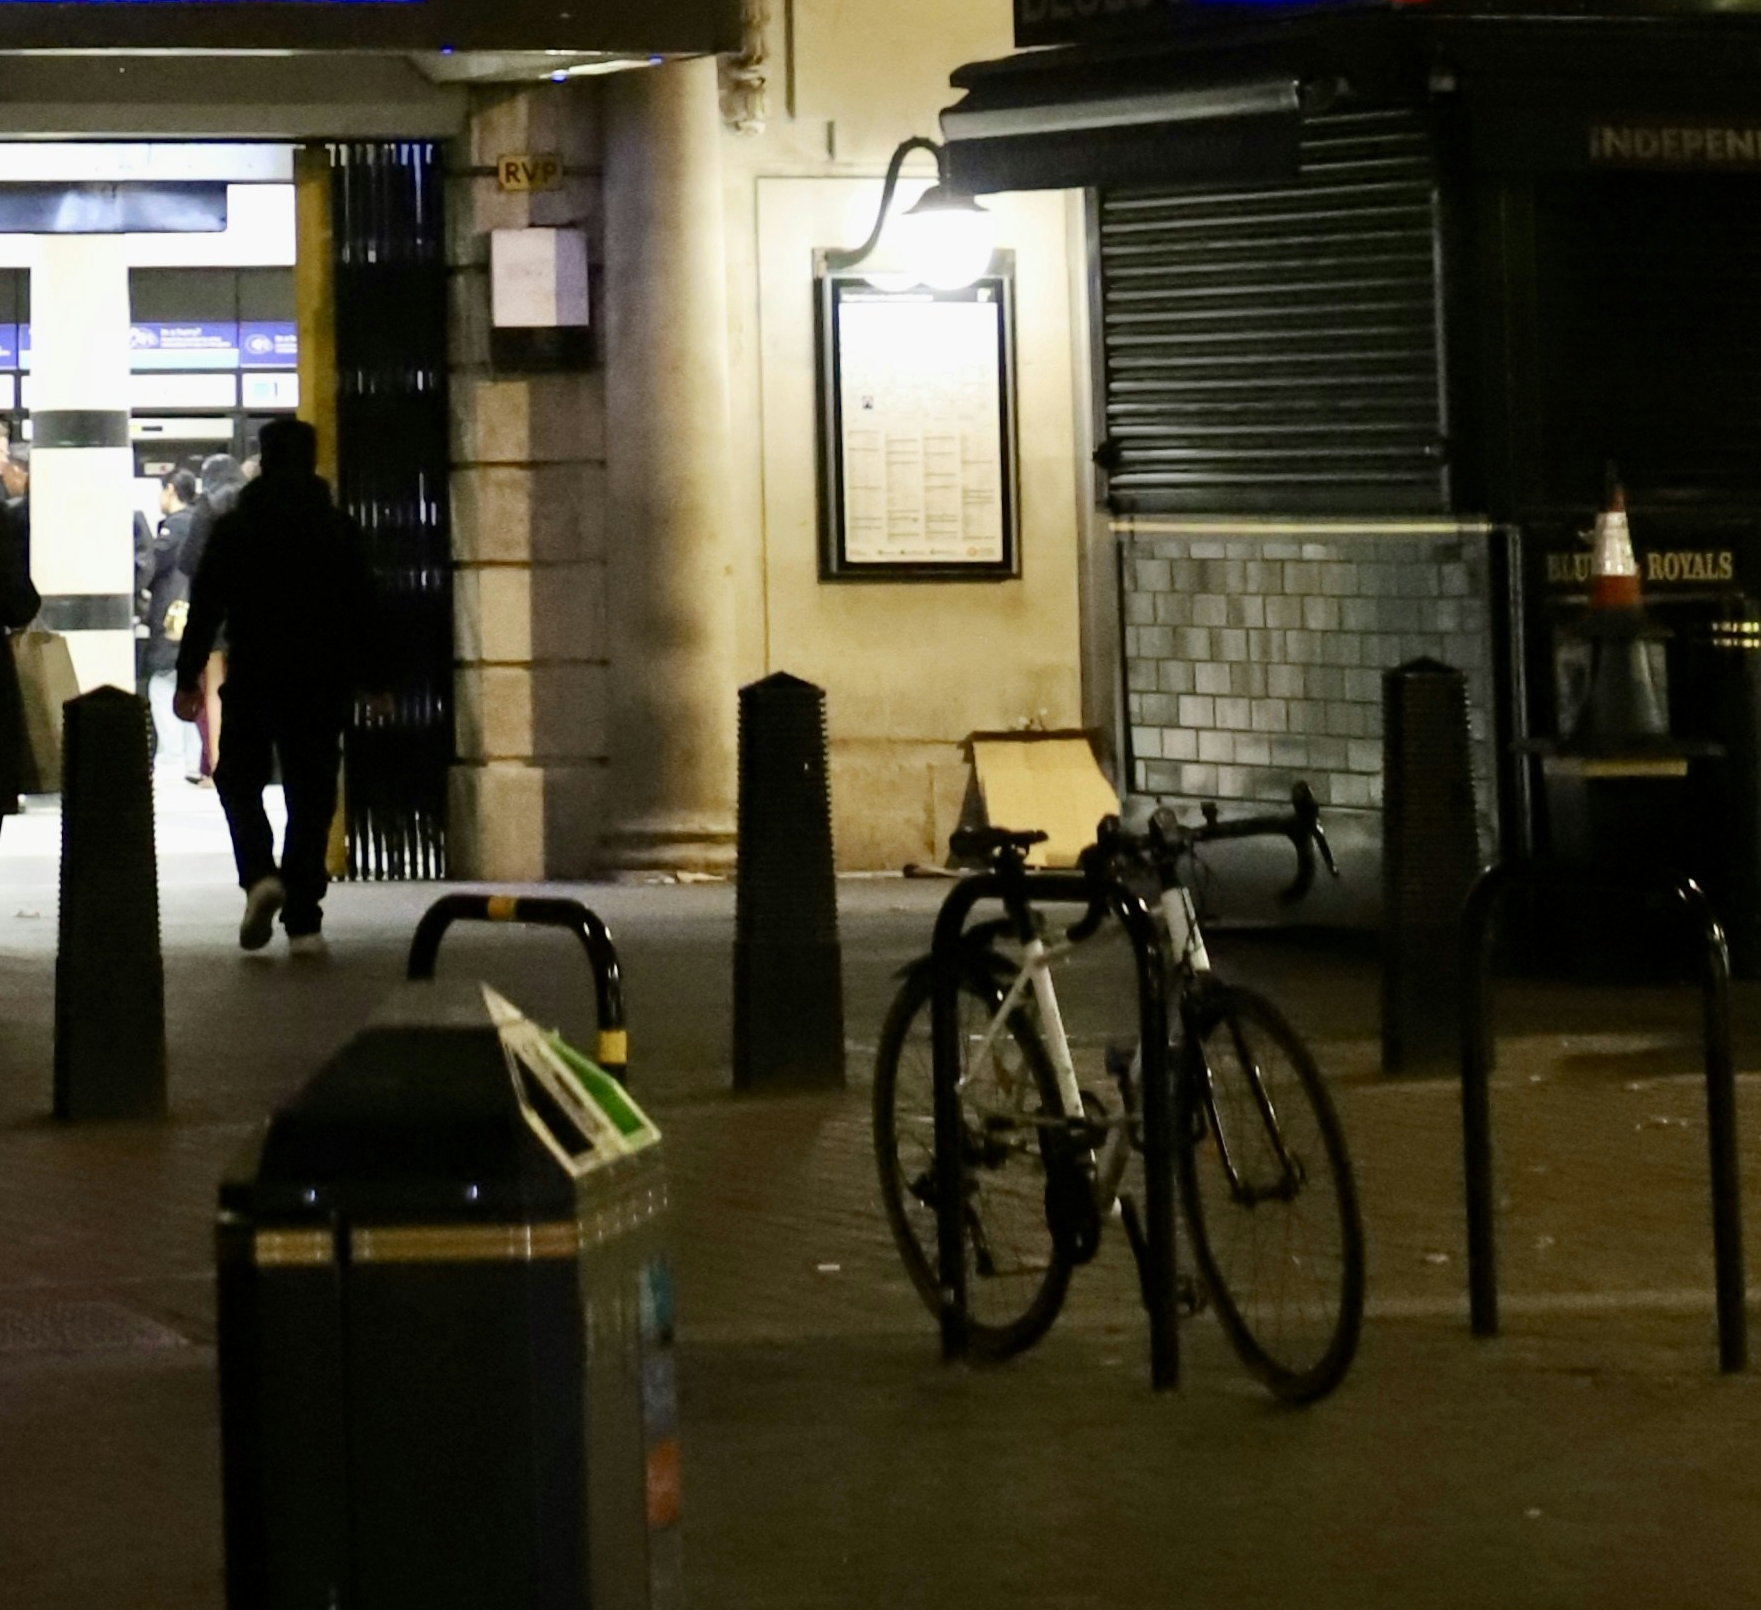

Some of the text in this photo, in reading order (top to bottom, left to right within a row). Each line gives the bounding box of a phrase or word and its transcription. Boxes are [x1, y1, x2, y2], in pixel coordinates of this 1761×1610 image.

[1589, 124, 1761, 161] INDEPEN
[504, 162, 557, 183] RVP
[1545, 551, 1734, 582] BLU ROYALS
